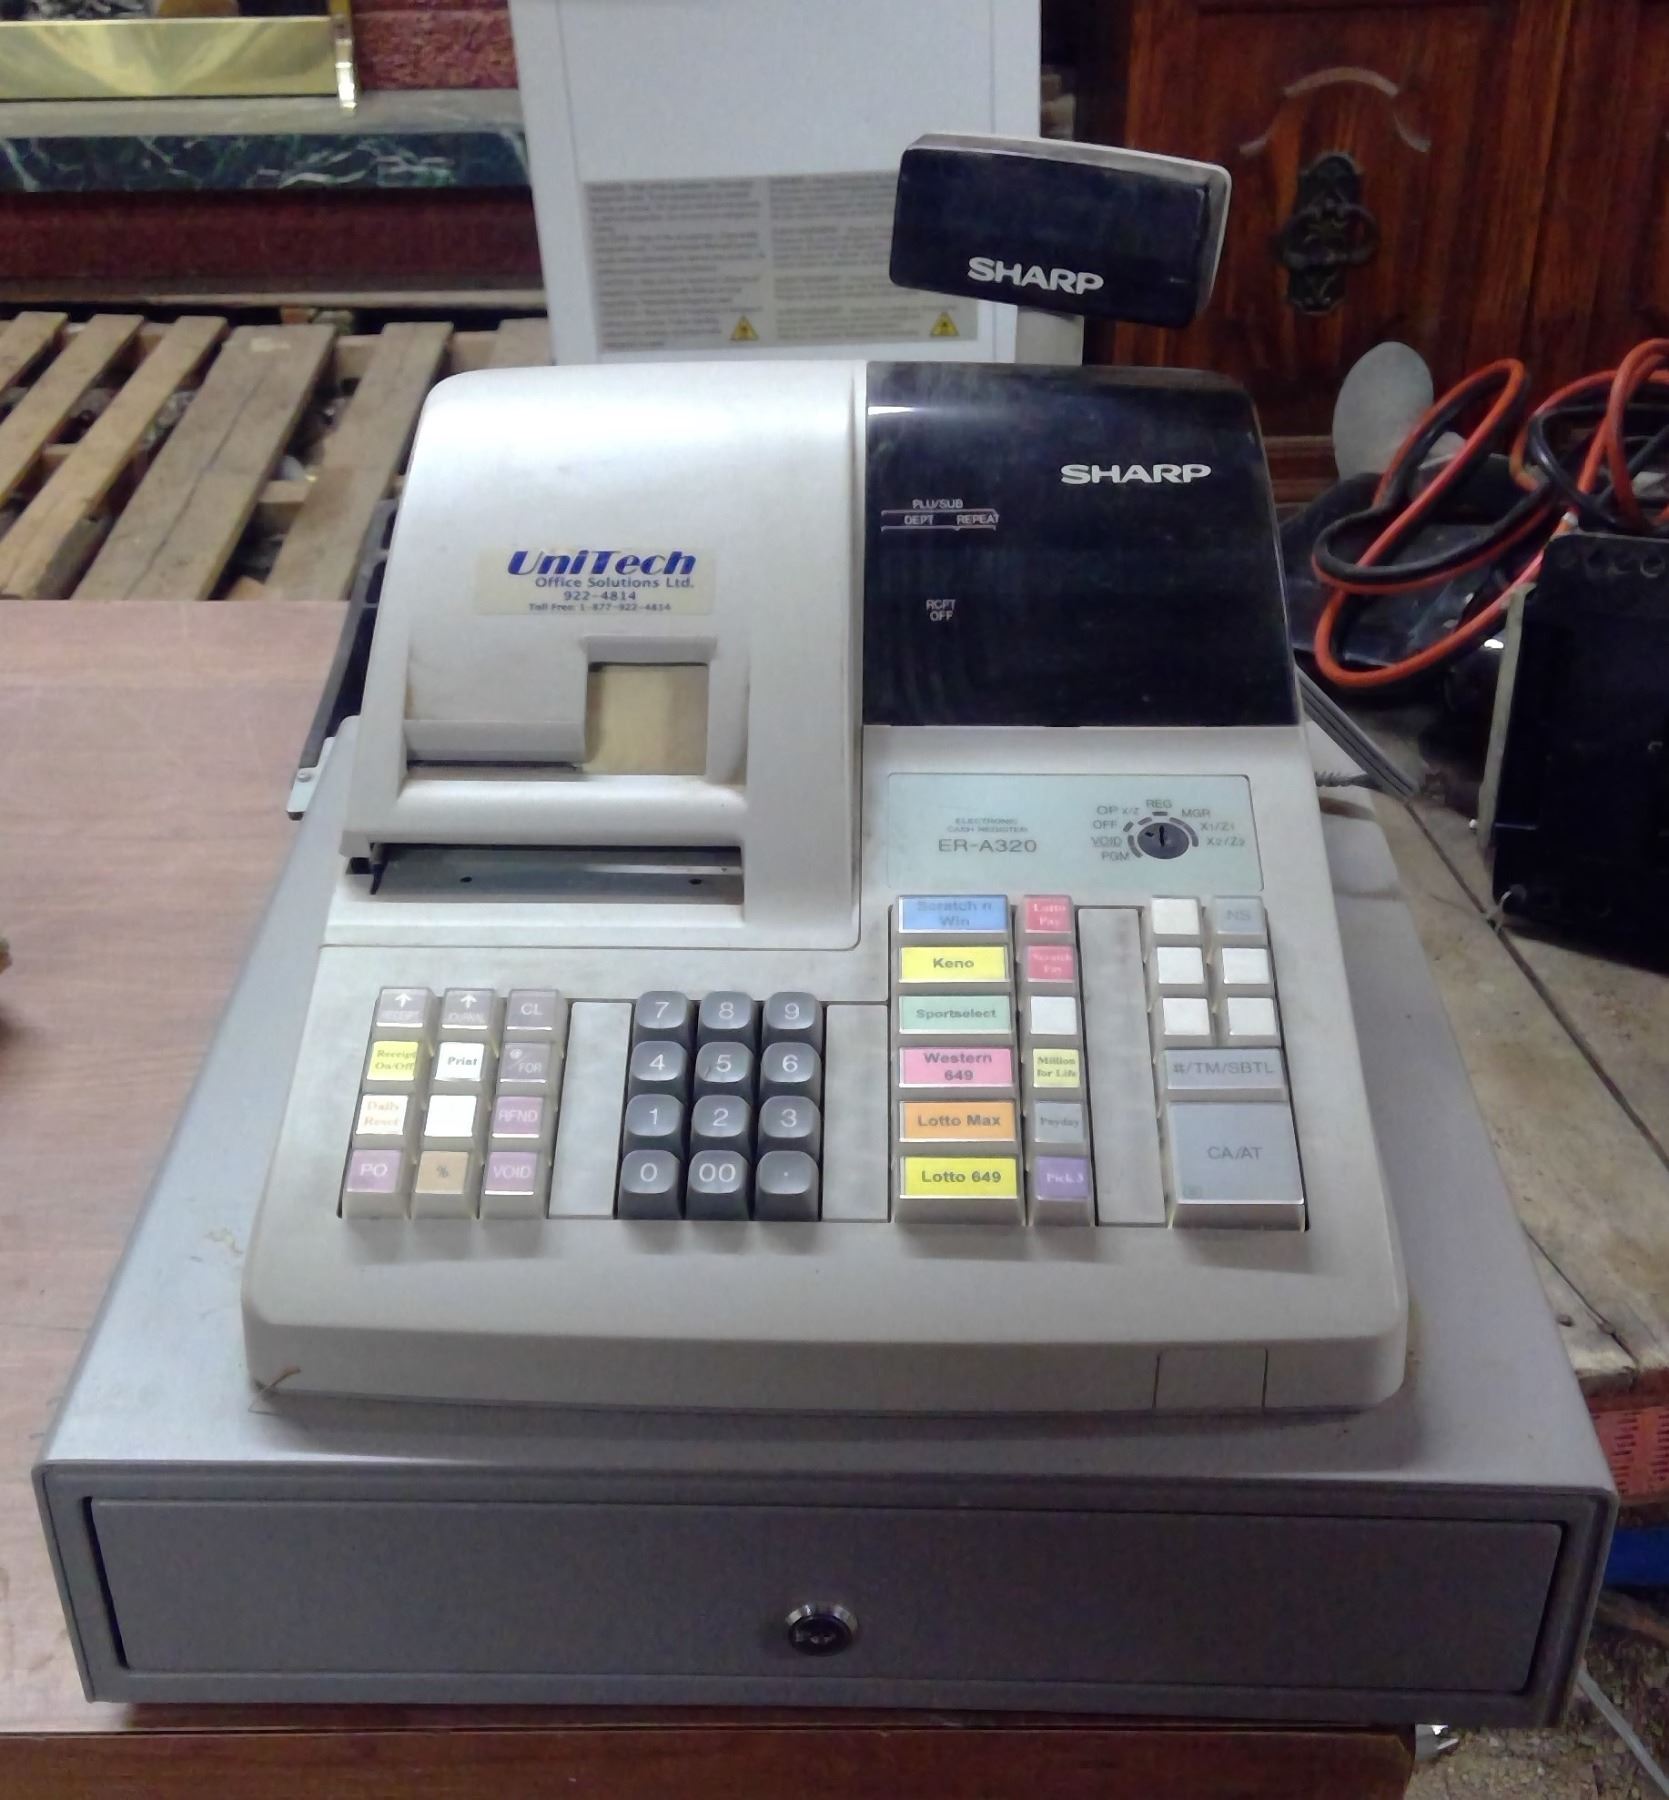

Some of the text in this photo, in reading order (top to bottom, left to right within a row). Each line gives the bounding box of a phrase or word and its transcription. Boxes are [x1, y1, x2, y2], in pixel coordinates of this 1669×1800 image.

[967, 256, 1104, 294] SHARP
[1060, 464, 1211, 484] SHARP
[912, 499, 963, 509] PLU/SUB
[904, 514, 999, 525] DEPT REPEAT
[507, 550, 696, 575] UniTech
[535, 577, 695, 588] Office Solutions Ltd.
[564, 591, 636, 601] 922-4814
[529, 603, 548, 612] Toll
[926, 599, 956, 610] RCPT
[930, 611, 953, 622] OFF
[1146, 799, 1172, 809] REG
[1096, 806, 1118, 816] OP
[1182, 808, 1210, 818] MGR
[1093, 820, 1117, 830] OFF
[938, 839, 1037, 853] ER-A320
[1091, 837, 1122, 847] VOID
[1101, 851, 1130, 862] PGM
[917, 901, 977, 912] Scratch
[940, 916, 970, 926] Win
[1227, 910, 1250, 920] NS
[933, 958, 975, 969] Keno
[521, 1003, 543, 1015] CL
[655, 1001, 670, 1019] 7
[718, 1001, 735, 1020] 8
[784, 1002, 800, 1020] 9
[915, 1009, 997, 1019] Sportselect
[447, 1056, 478, 1066] Print
[649, 1054, 666, 1071] 4
[716, 1054, 732, 1072] 5
[782, 1054, 799, 1072] 6
[924, 1052, 992, 1064] Western
[375, 1061, 415, 1071] On/Off
[1173, 1061, 1274, 1075] #/TM/SBTL
[944, 1070, 974, 1081] 649
[499, 1111, 538, 1123] RFND
[649, 1108, 659, 1125] 1
[713, 1108, 729, 1127] 2
[780, 1108, 797, 1127] 3
[917, 1115, 1001, 1127] Lotto Max
[1207, 1147, 1262, 1160] CA/AT
[360, 1163, 388, 1177] PO
[493, 1165, 532, 1179] VOID
[640, 1163, 658, 1182] 0
[699, 1163, 736, 1182] 00
[922, 1171, 1001, 1183] Lotto 649
